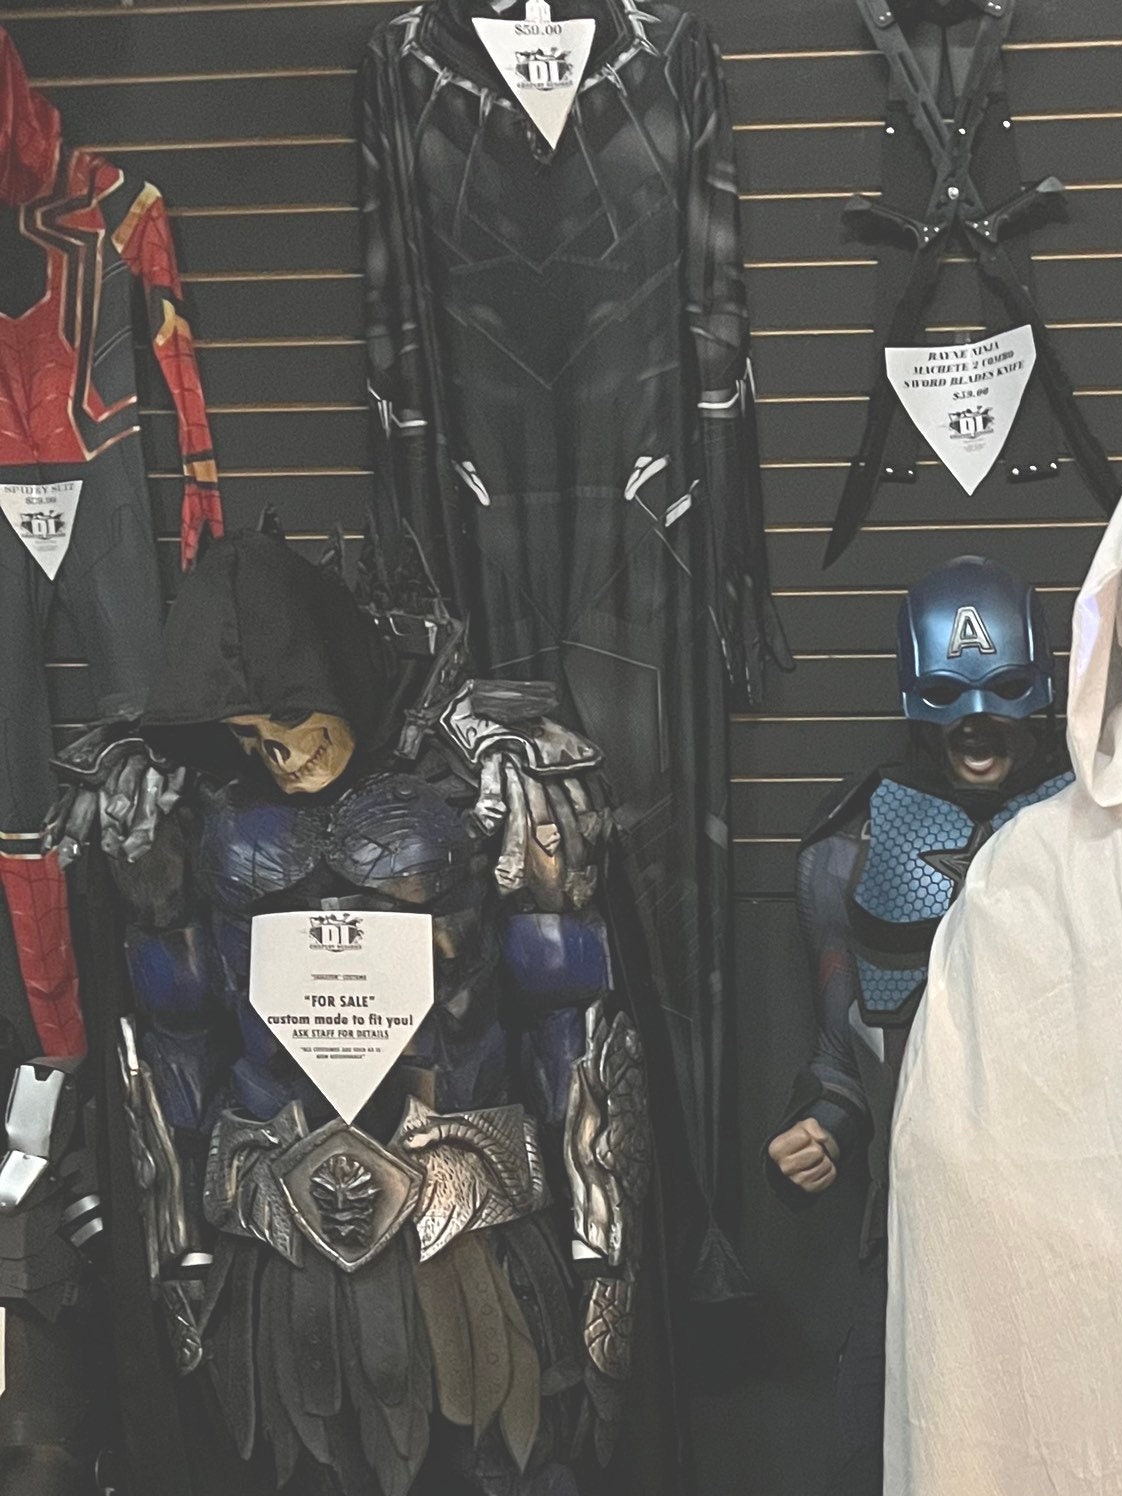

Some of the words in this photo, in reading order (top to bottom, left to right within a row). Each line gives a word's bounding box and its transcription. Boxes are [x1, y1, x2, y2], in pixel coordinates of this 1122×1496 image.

[928, 350, 967, 361] RAYNE
[972, 341, 1000, 356] NINJA
[913, 362, 969, 375] MACHETE
[972, 361, 979, 370] 2
[982, 350, 1015, 367] COMBO
[904, 377, 947, 388] SWORD
[949, 371, 994, 386] BLADES
[996, 360, 1025, 377] KNIFE
[947, 605, 996, 660] A
[267, 1014, 310, 1025] custom
[314, 1013, 349, 1026] made
[352, 1014, 365, 1026] to
[368, 1013, 383, 1026] fit
[385, 1014, 413, 1028] you!
[292, 1030, 309, 1039] ASK
[311, 1030, 335, 1039] STAFF
[337, 1030, 354, 1039] FOR
[356, 1030, 389, 1039] DETAILS
